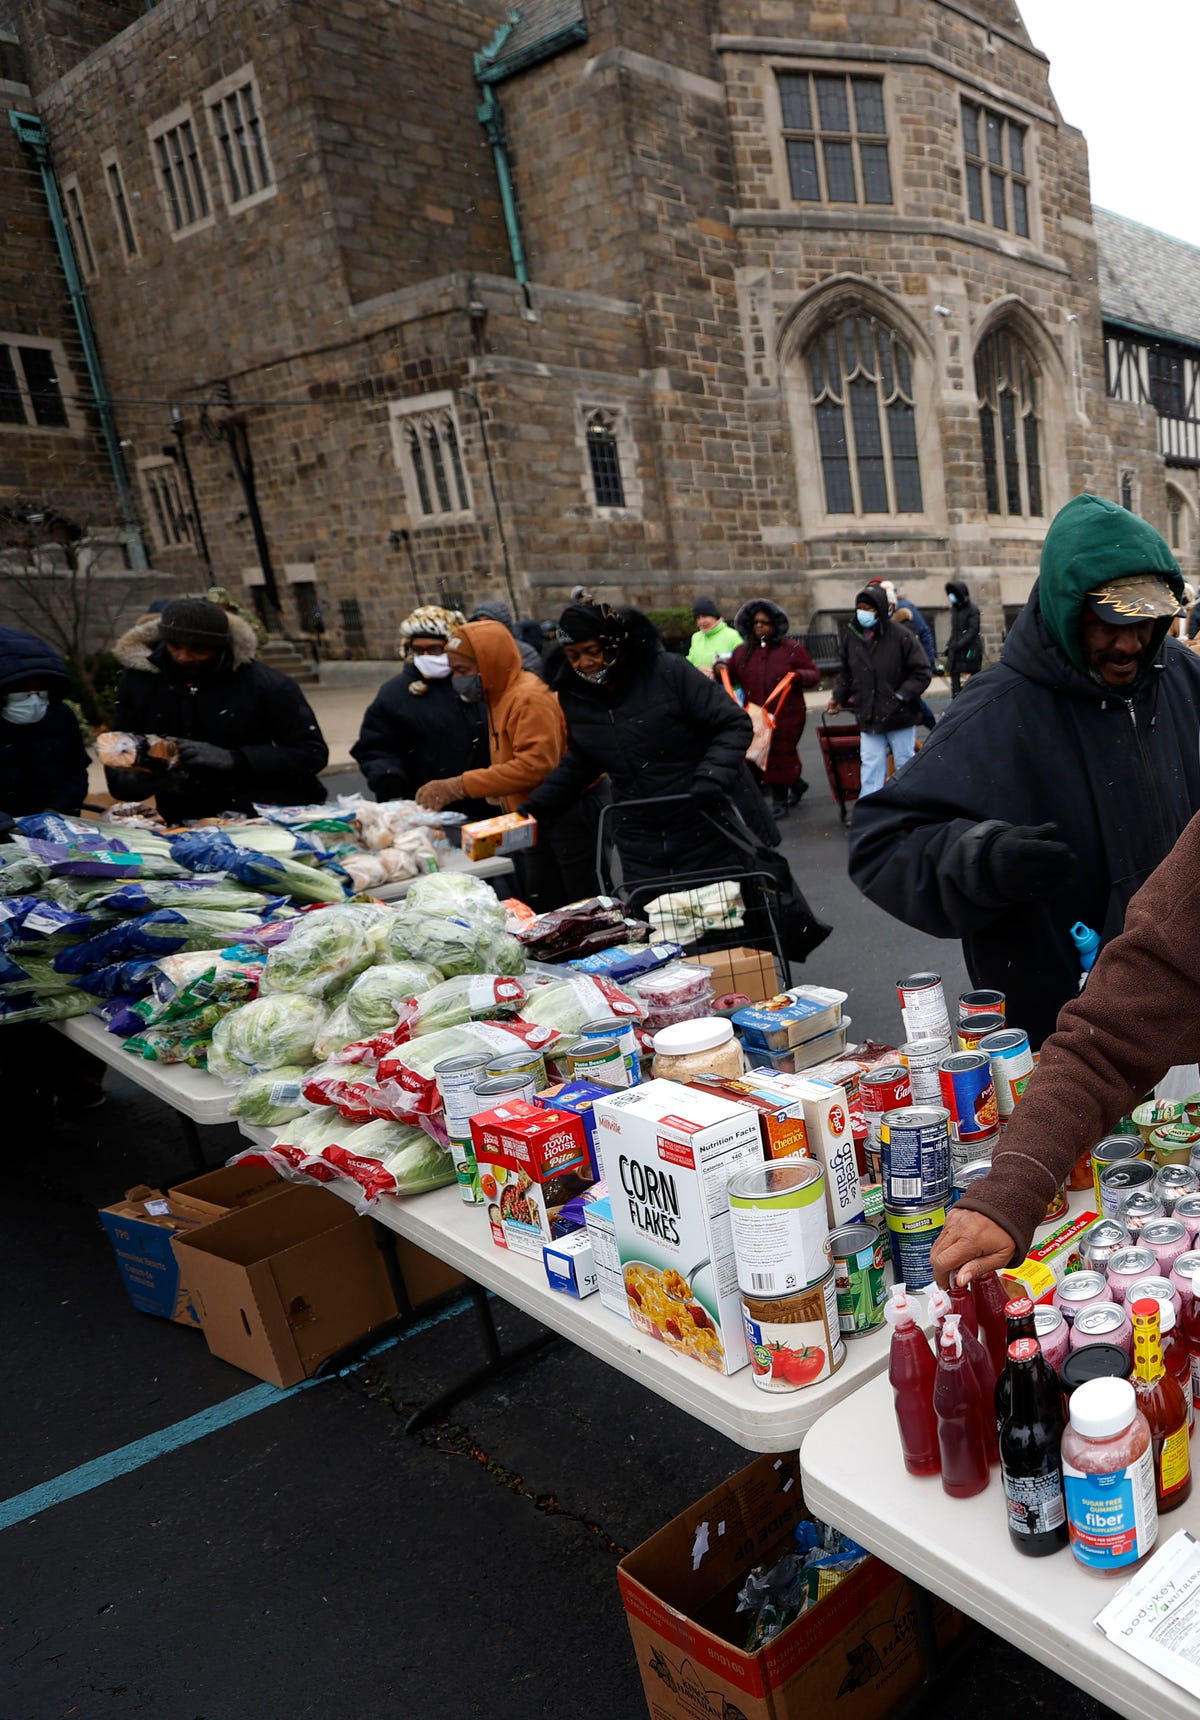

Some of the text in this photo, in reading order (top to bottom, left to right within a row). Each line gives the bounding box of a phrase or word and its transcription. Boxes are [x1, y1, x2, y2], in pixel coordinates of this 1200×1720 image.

[830, 1108, 844, 1132] Post
[543, 1133, 574, 1151] TOWN
[699, 1126, 756, 1153] Nutrition Facts
[773, 1131, 804, 1151] Cheerios
[543, 1140, 577, 1161] HOUSE
[549, 1152, 576, 1168] Pita
[702, 1161, 724, 1174] Calories
[843, 1142, 859, 1190] great
[619, 1154, 680, 1219] CORN
[829, 1149, 851, 1209] grains
[629, 1198, 680, 1247] FLAKES
[904, 1218, 931, 1231] PROGRESSO
[1019, 1338, 1030, 1357] IBC
[1082, 1496, 1123, 1507] SUGAR FREE
[1090, 1505, 1123, 1513] GUMMIES
[1085, 1513, 1124, 1527] fiber
